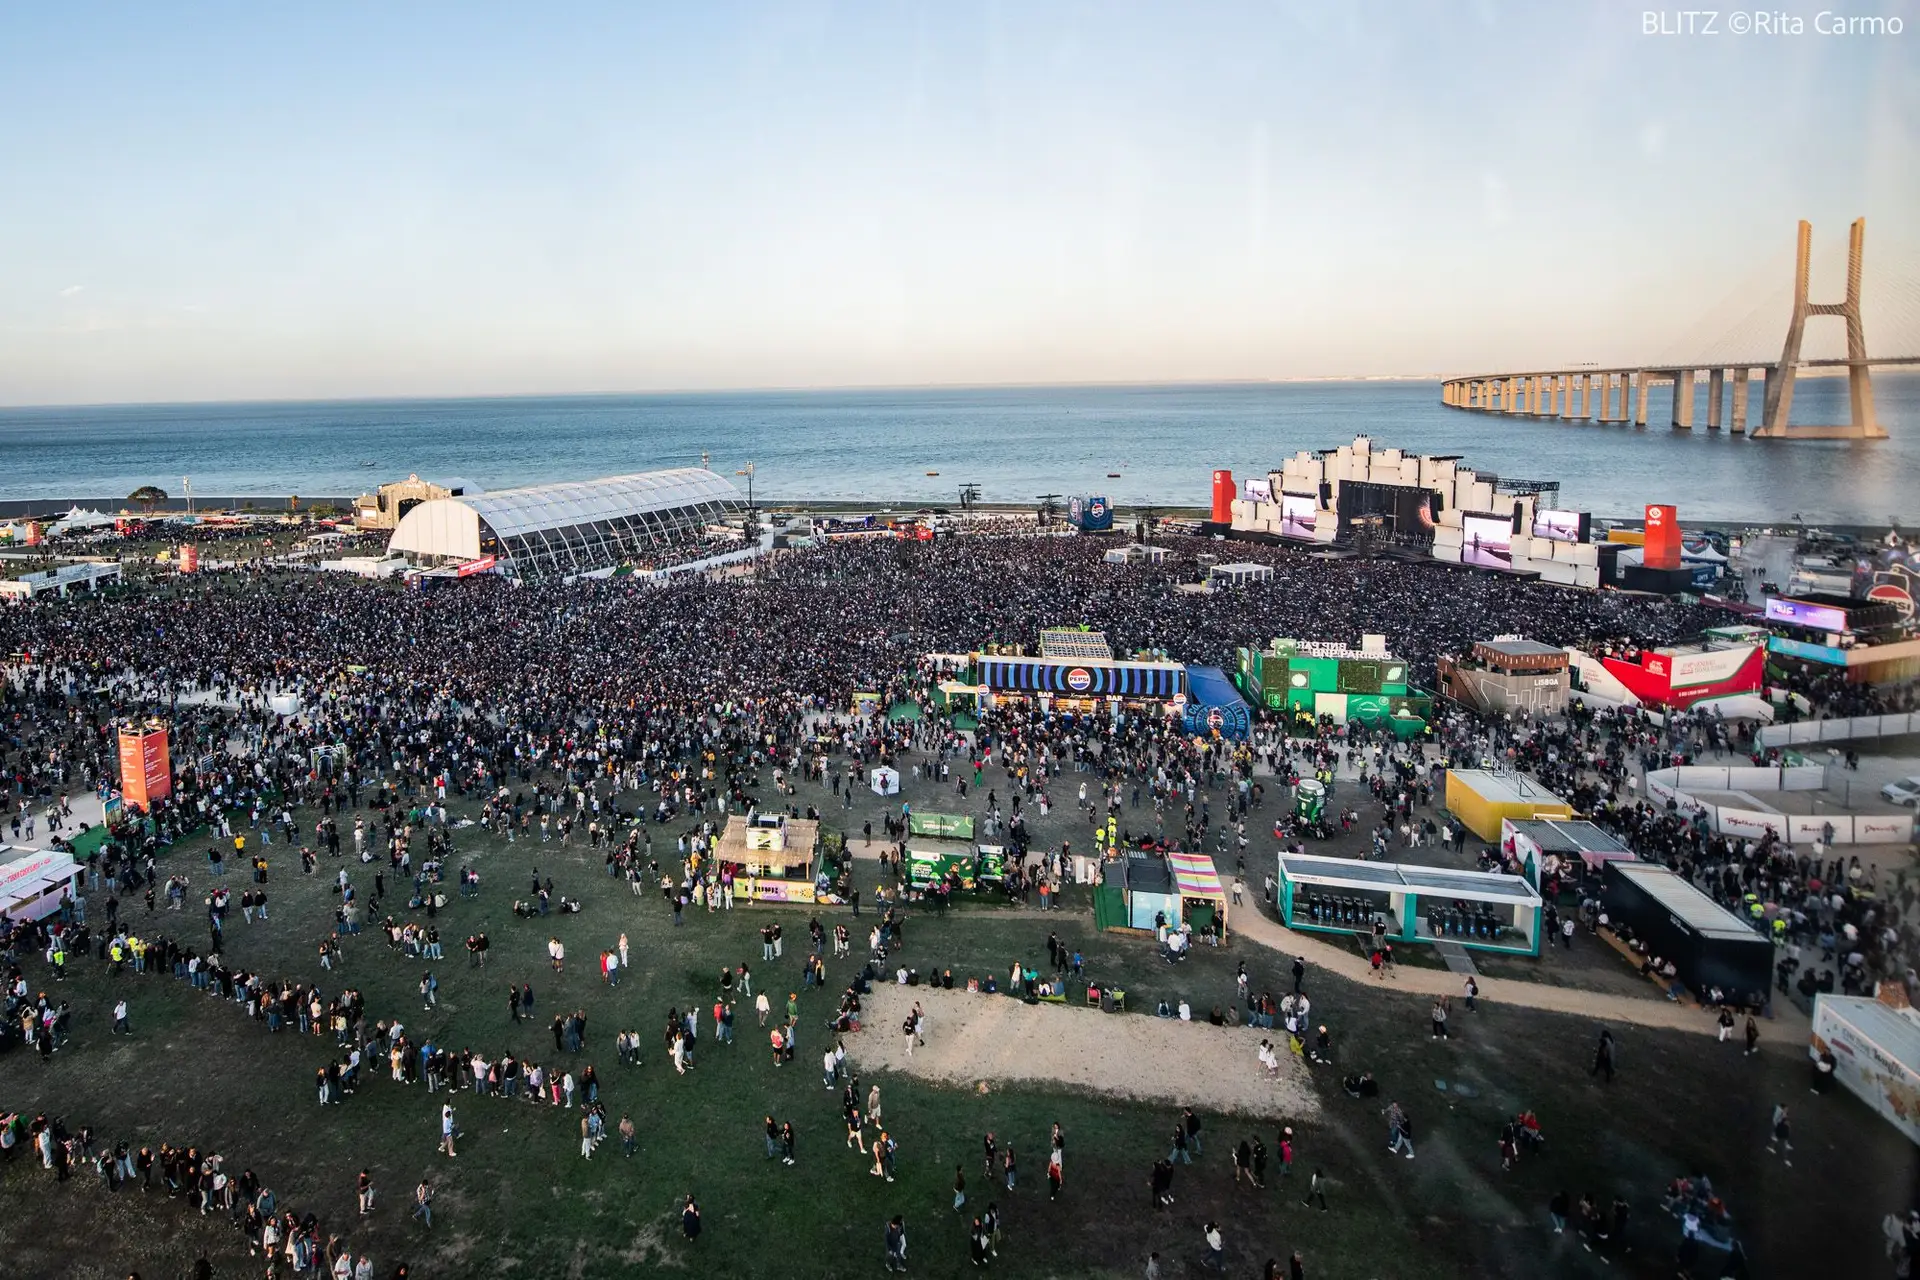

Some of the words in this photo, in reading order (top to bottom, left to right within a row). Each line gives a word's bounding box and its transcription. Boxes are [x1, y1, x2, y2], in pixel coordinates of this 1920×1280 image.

[1313, 649, 1337, 658] BNP
[1534, 678, 1558, 687] LISBOA
[1037, 691, 1054, 699] BAR
[1106, 694, 1123, 702] BAR
